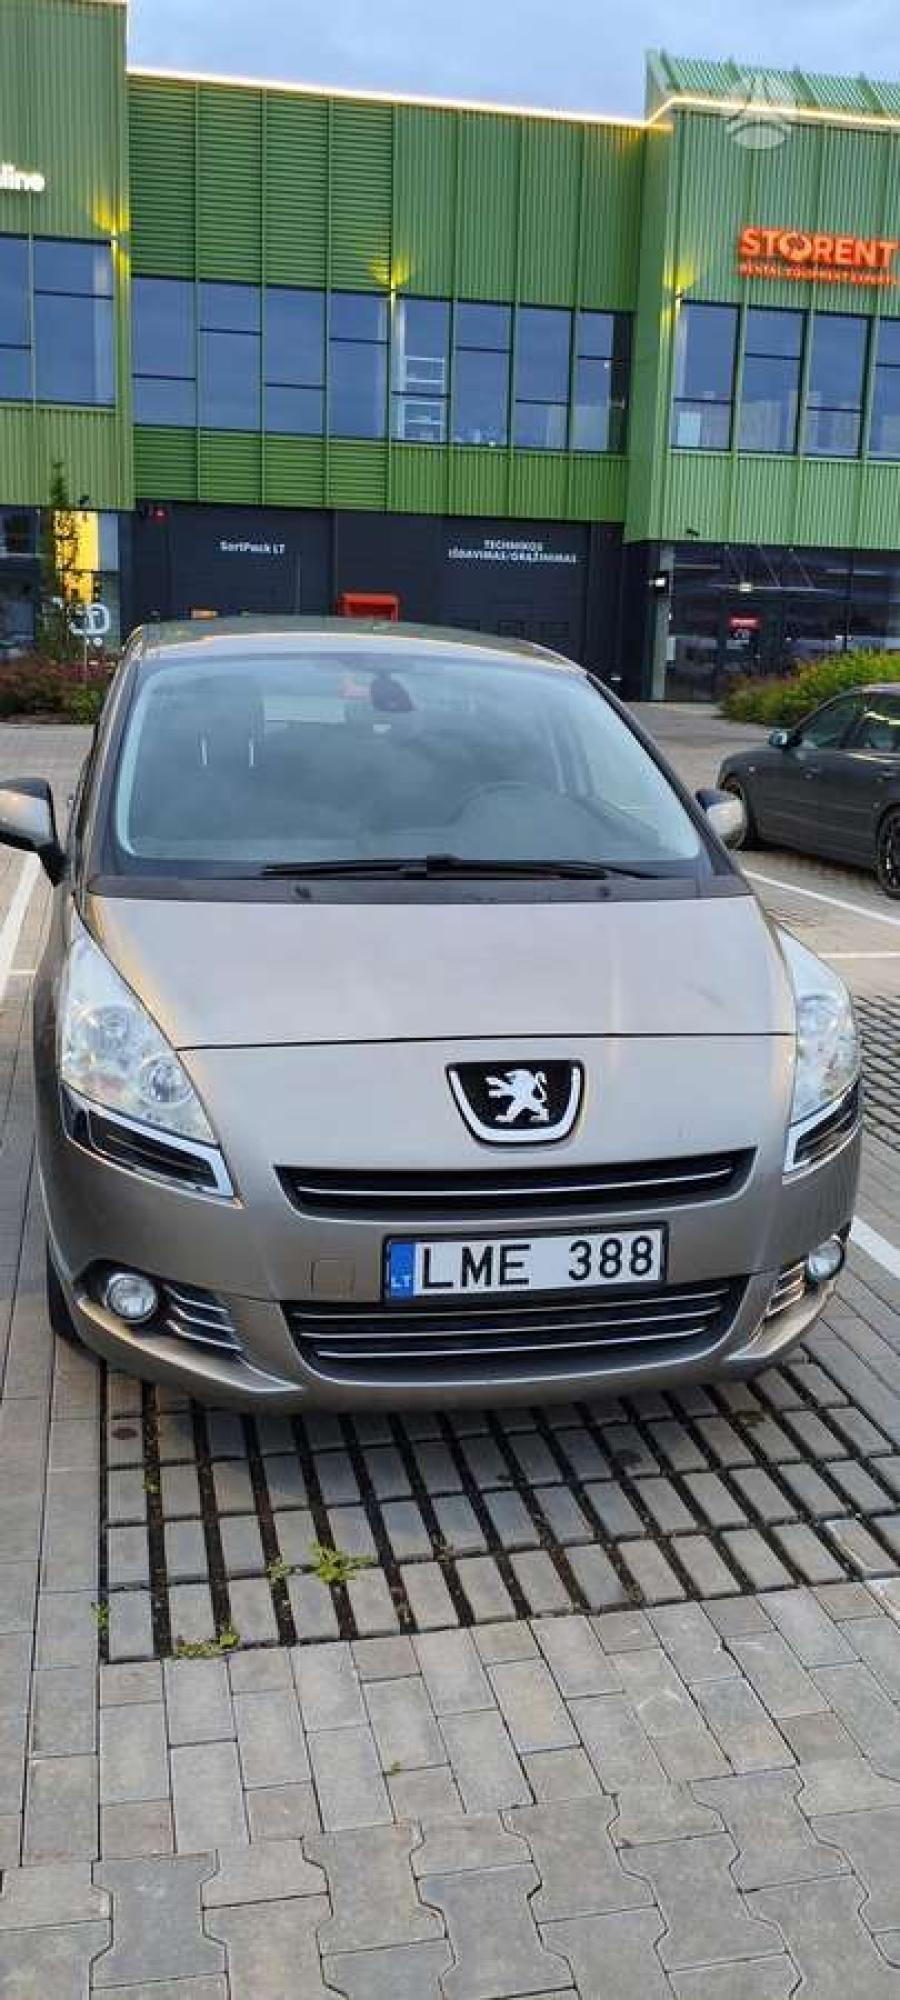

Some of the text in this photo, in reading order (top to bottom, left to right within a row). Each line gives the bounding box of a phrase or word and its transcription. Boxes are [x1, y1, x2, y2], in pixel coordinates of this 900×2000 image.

[0, 163, 45, 192] line
[740, 227, 898, 269] STORENT
[220, 540, 285, 554] SortPack LT
[391, 1235, 654, 1290] LT LME 388
